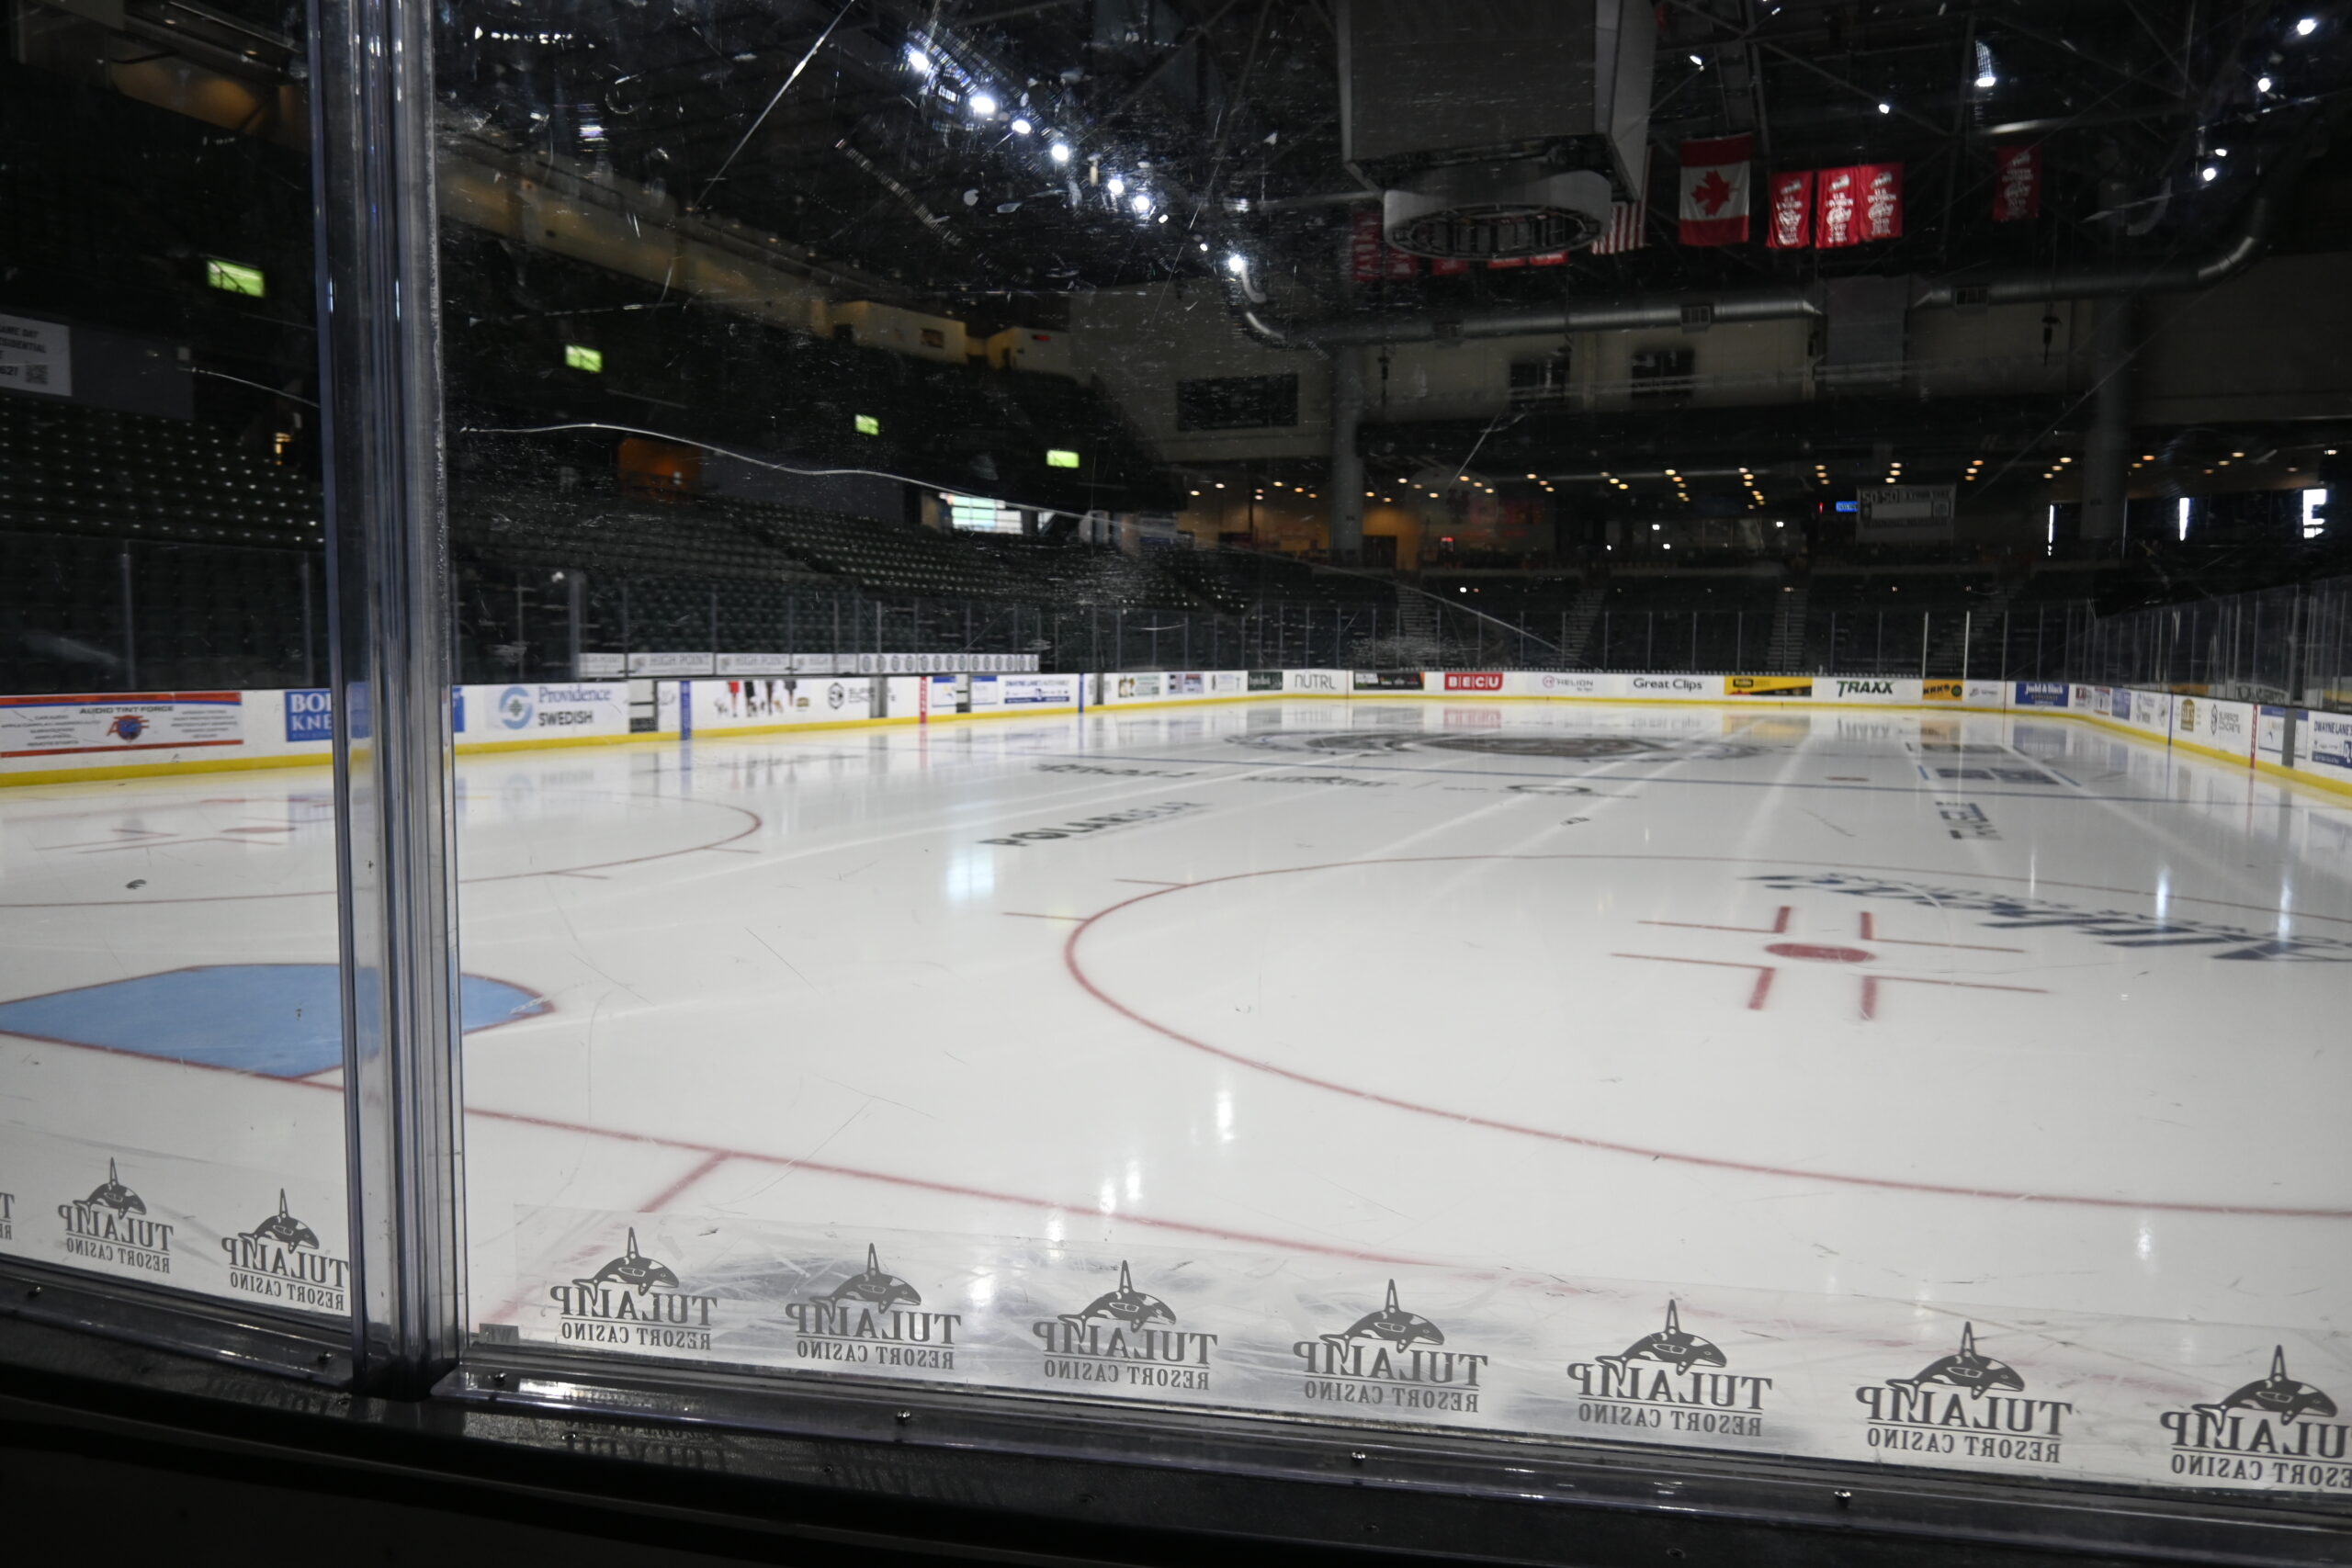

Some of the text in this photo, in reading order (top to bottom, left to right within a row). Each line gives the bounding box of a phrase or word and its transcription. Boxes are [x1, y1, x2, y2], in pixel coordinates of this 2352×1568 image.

[1447, 674, 1499, 687] BECU
[1633, 677, 1703, 693] Great Clips
[538, 686, 612, 704] Providence
[1836, 680, 1894, 698] TRAXX
[79, 706, 114, 715] AUDIO
[141, 705, 174, 714] FORCE
[290, 693, 332, 714] BO
[538, 710, 594, 727] SWEDISH
[2313, 719, 2335, 734] DWAYNE
